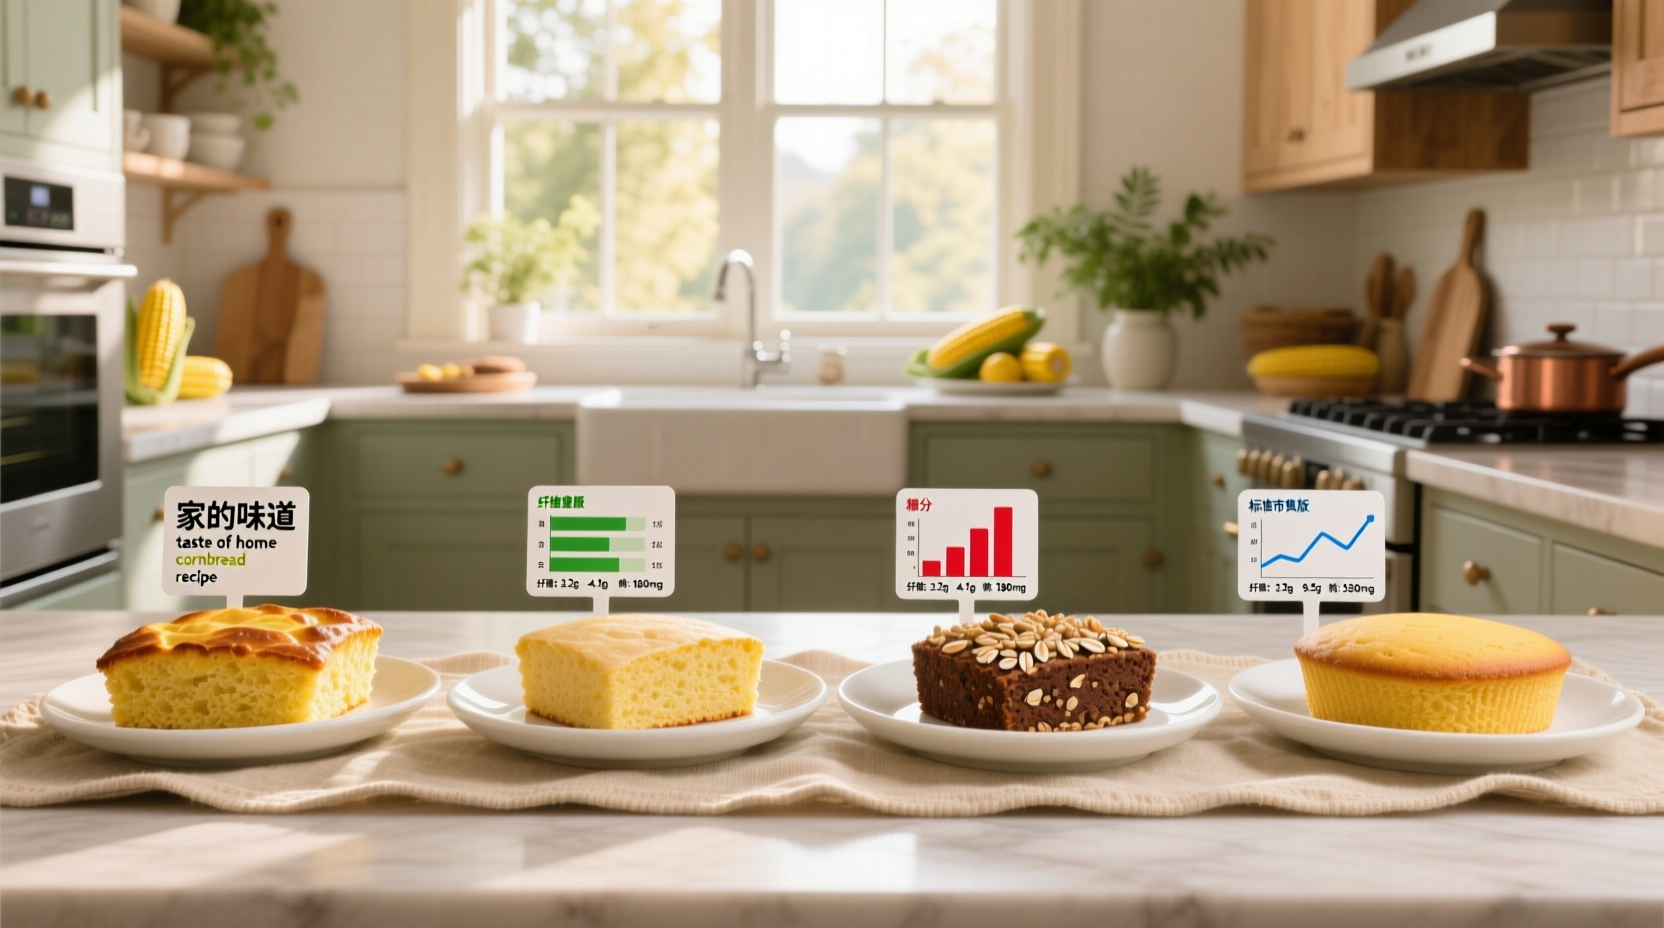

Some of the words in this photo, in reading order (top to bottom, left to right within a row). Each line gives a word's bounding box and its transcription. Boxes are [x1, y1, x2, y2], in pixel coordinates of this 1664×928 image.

[176, 500, 296, 531] 家的味道
[176, 535, 212, 549] taste
[217, 534, 232, 549] of
[236, 535, 277, 549] home
[176, 552, 246, 566] cornbread
[176, 570, 218, 587] recipe
